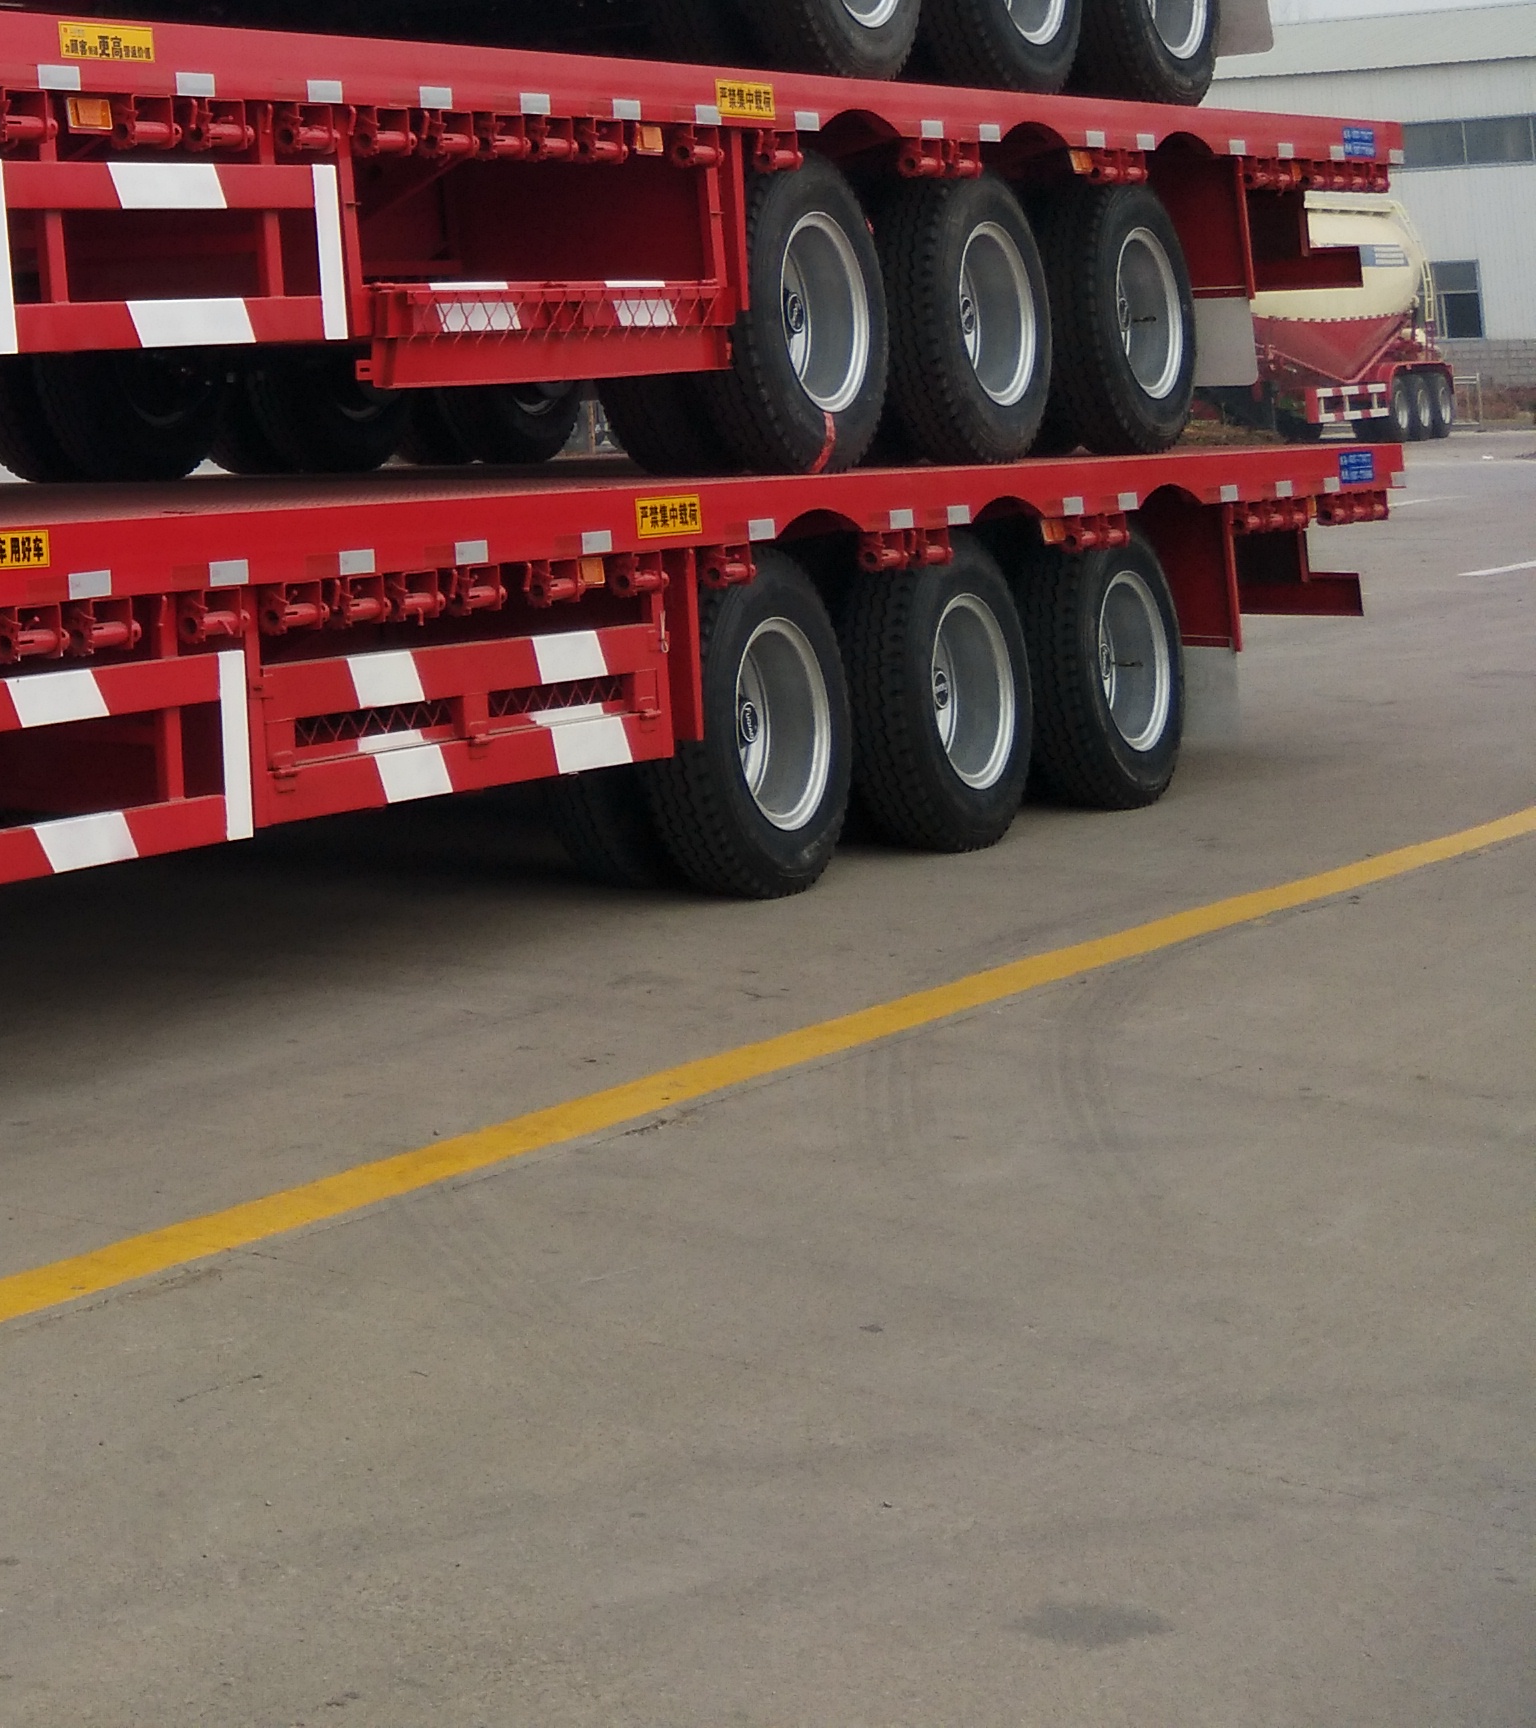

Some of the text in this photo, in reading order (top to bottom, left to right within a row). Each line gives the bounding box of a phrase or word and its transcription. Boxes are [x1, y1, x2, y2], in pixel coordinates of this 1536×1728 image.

[639, 502, 697, 529] 严禁集中载荷
